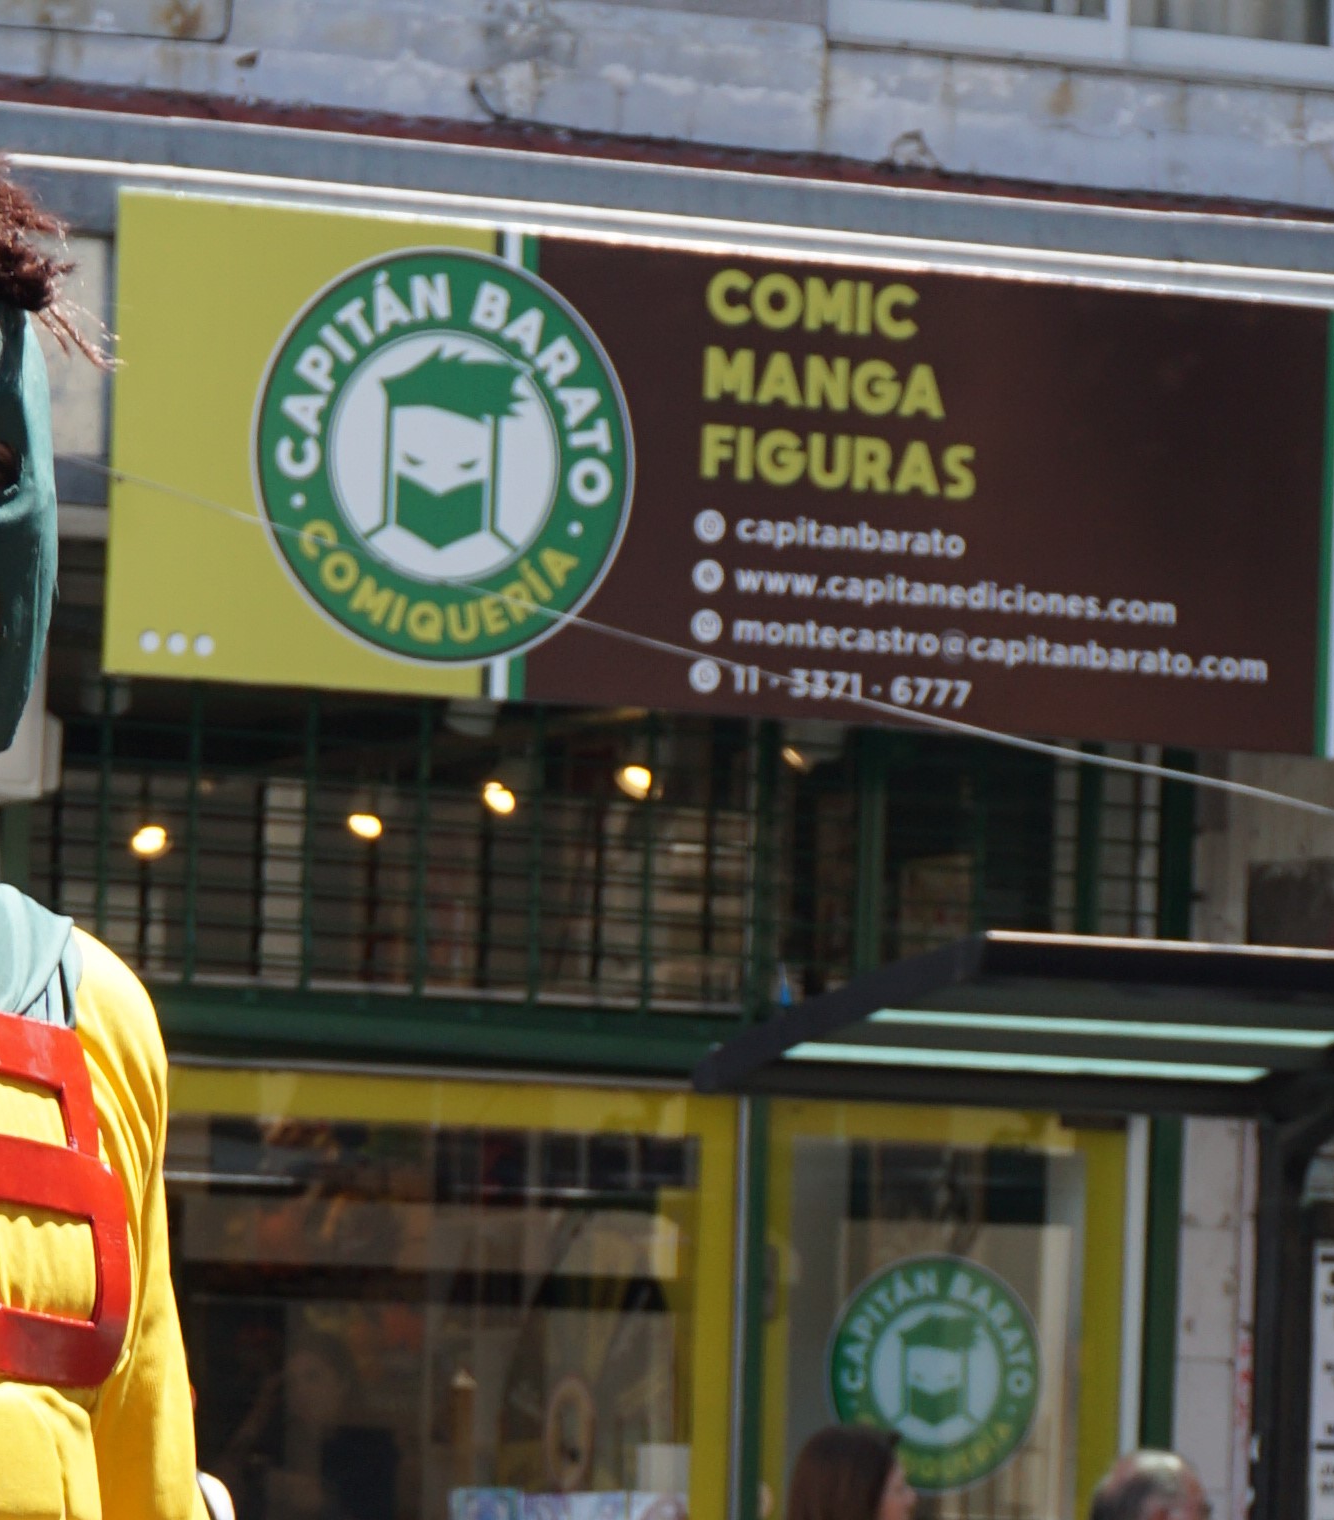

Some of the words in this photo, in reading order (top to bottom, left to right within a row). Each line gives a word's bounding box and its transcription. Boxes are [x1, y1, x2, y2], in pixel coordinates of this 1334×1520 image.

[706, 268, 919, 341] COMIC
[275, 271, 451, 479] CAPITÁN
[470, 281, 612, 507] BARATO
[703, 346, 945, 419] MANGA
[701, 423, 976, 500] FIGURAS
[734, 515, 966, 559] capitanbarato
[298, 519, 578, 644] COMIQUERÍA
[734, 566, 1177, 626] www.capitanediciones.com
[731, 614, 1269, 683] montecastro@capitanbarato.com
[733, 663, 760, 695] 11
[889, 674, 971, 708] 6777
